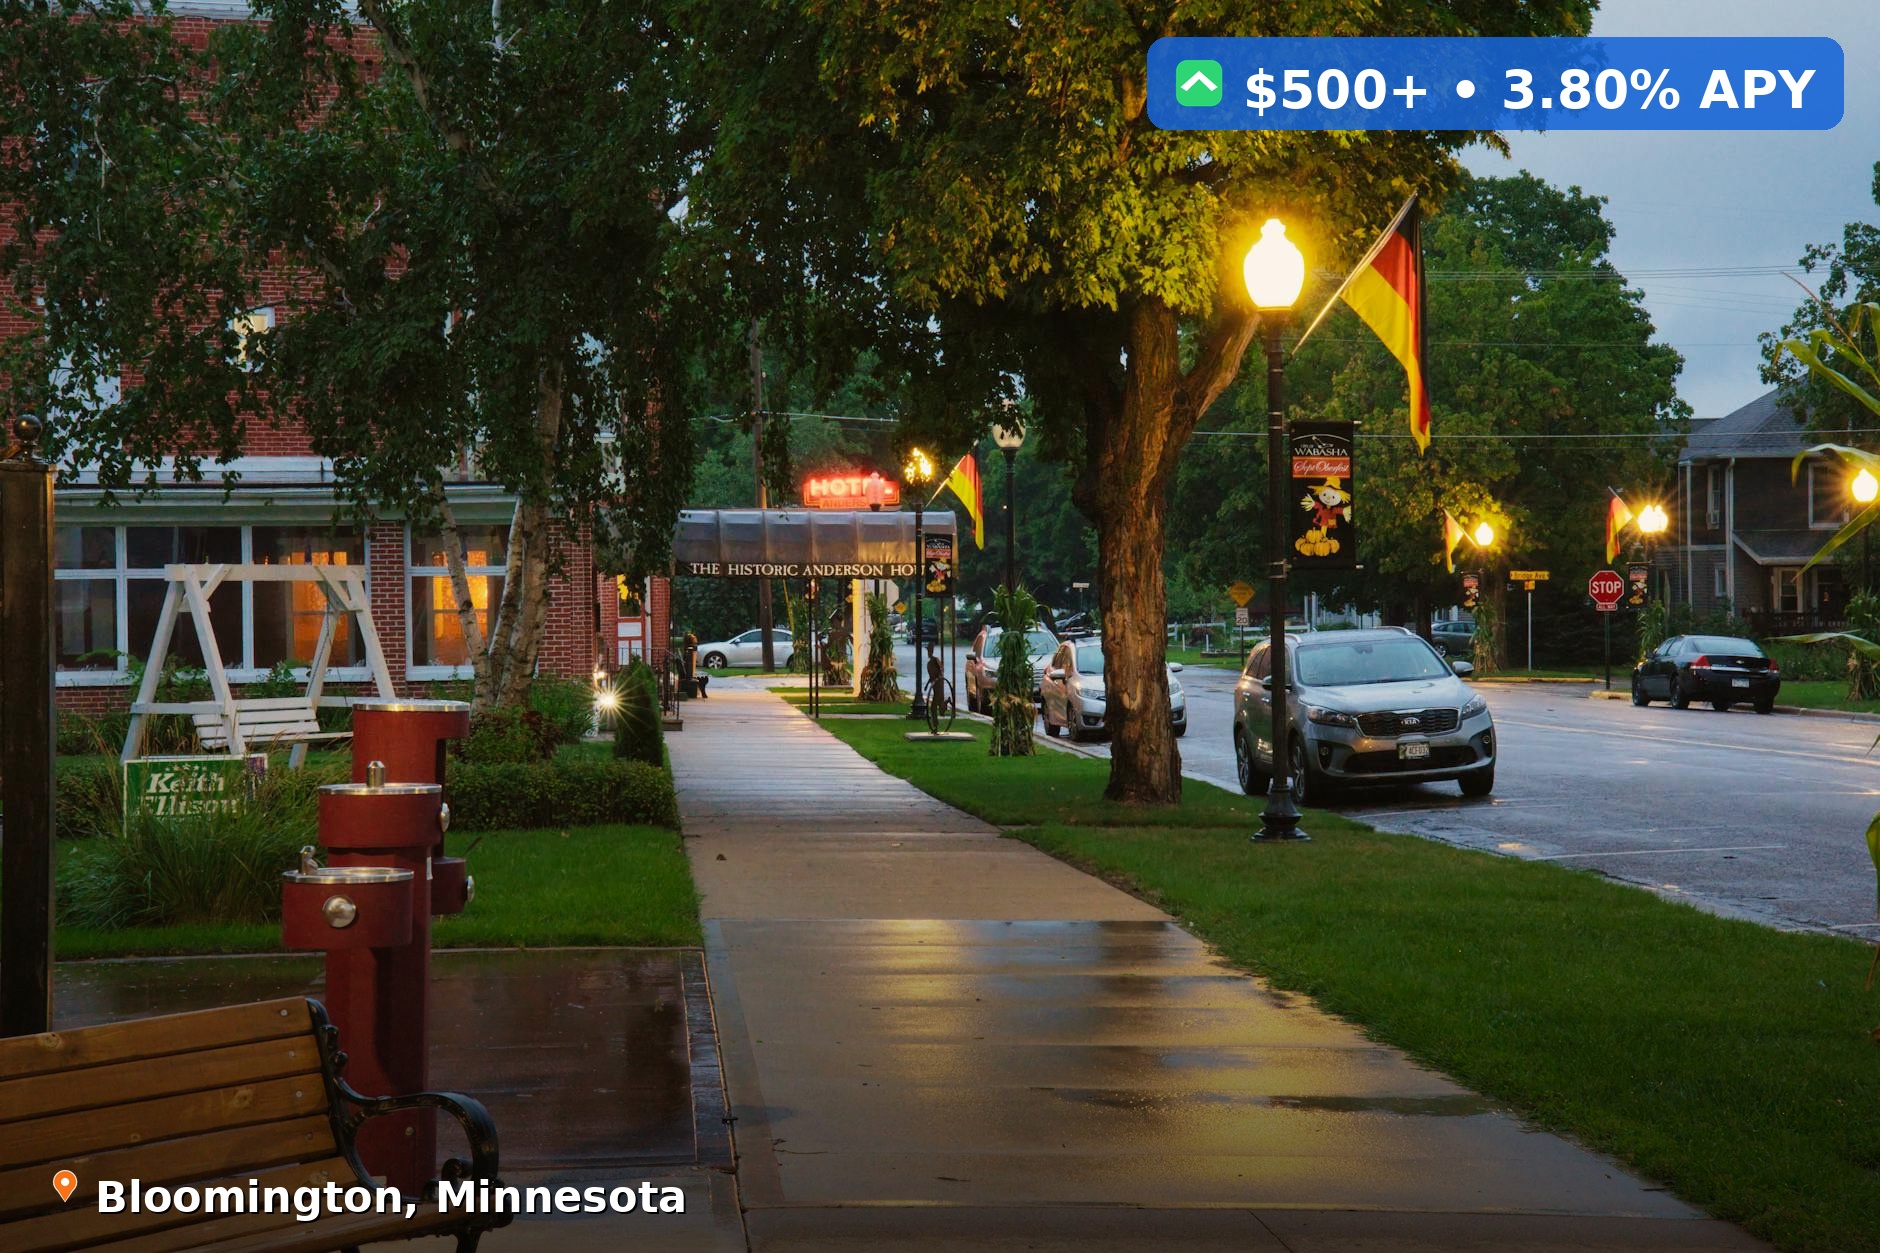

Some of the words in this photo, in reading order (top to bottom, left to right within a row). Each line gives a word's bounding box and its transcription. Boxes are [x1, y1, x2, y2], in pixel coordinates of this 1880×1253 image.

[1294, 447, 1348, 456] WABASHA
[690, 562, 720, 575] THE
[727, 563, 799, 576] HISTORIC
[803, 564, 884, 577] ANDERSON
[890, 564, 926, 577] HOU
[1591, 580, 1622, 594] STOP
[1236, 616, 1248, 624] 20
[146, 772, 225, 793] Keith
